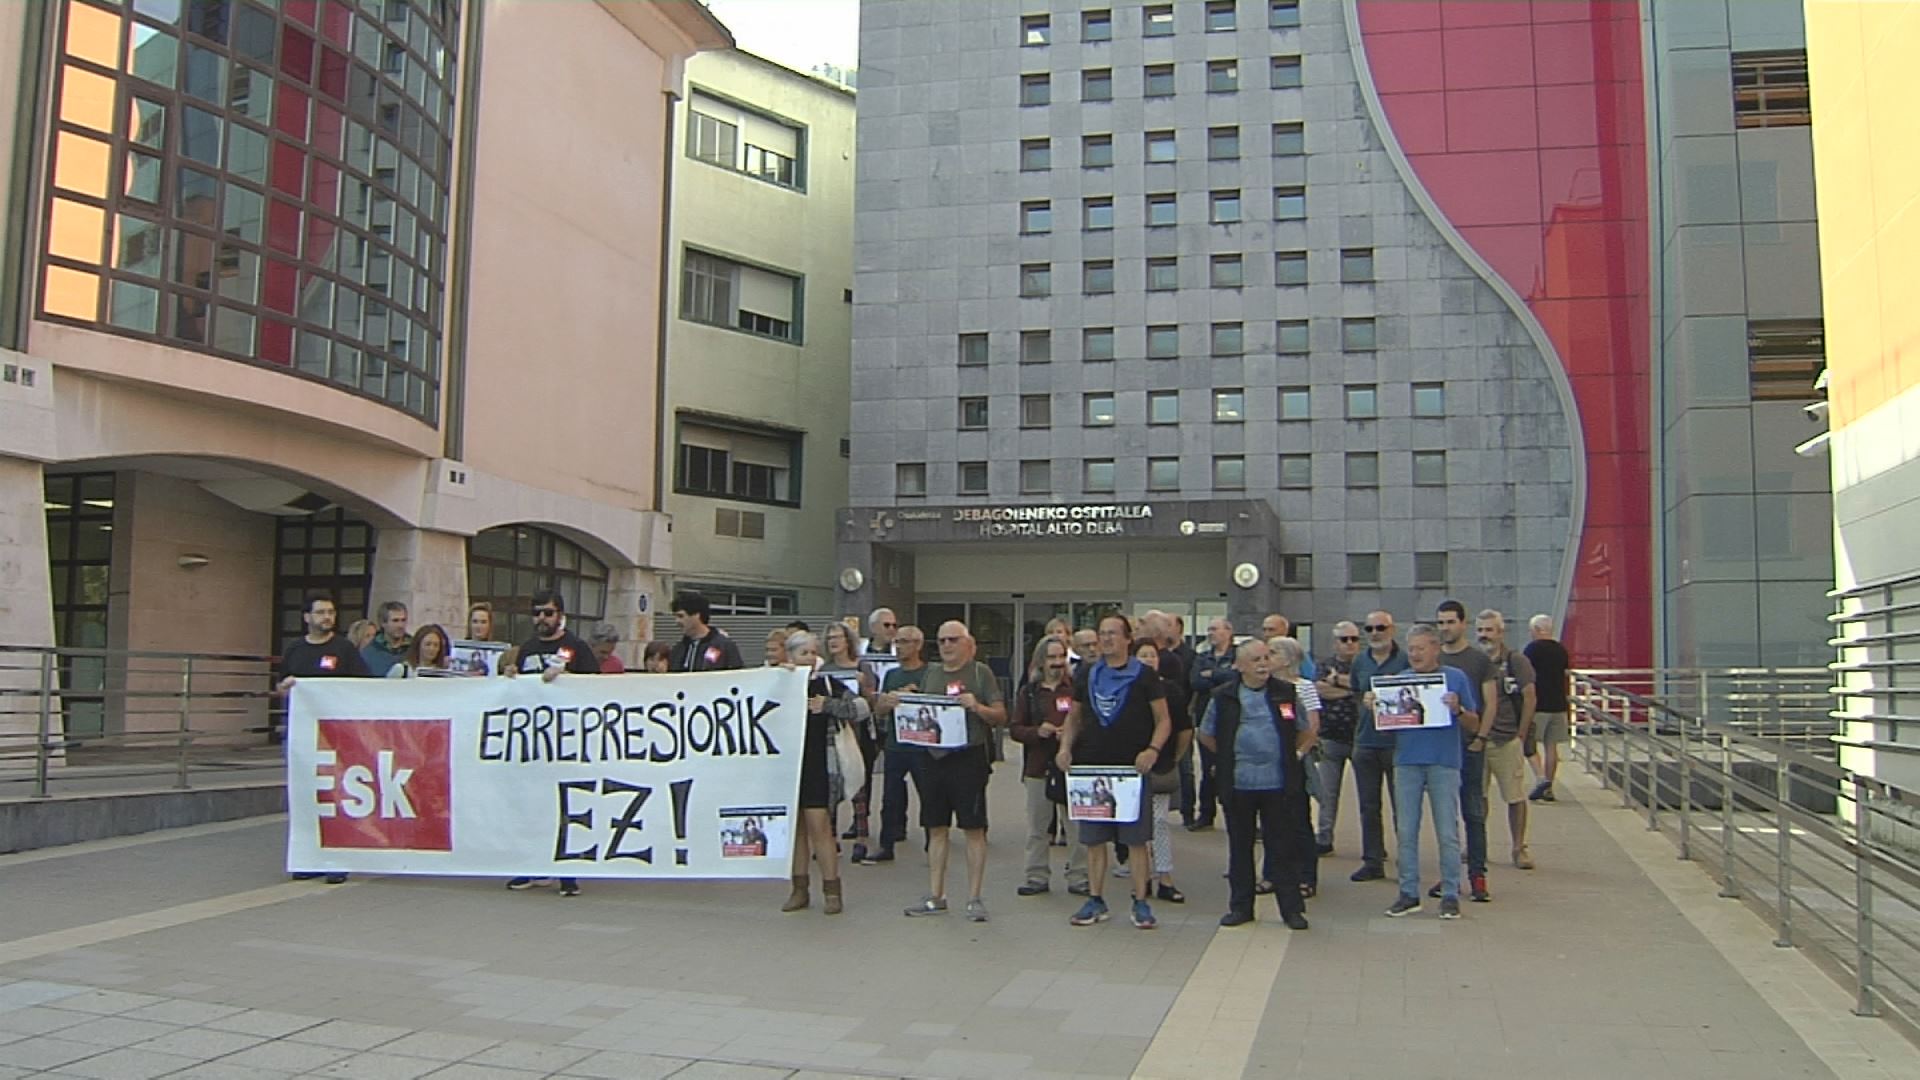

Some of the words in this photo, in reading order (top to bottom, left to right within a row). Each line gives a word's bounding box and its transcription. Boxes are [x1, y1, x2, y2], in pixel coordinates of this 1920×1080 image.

[979, 524, 1045, 537] HOSPITAL
[1047, 522, 1083, 535] ALTO
[1086, 522, 1124, 535] DEBA
